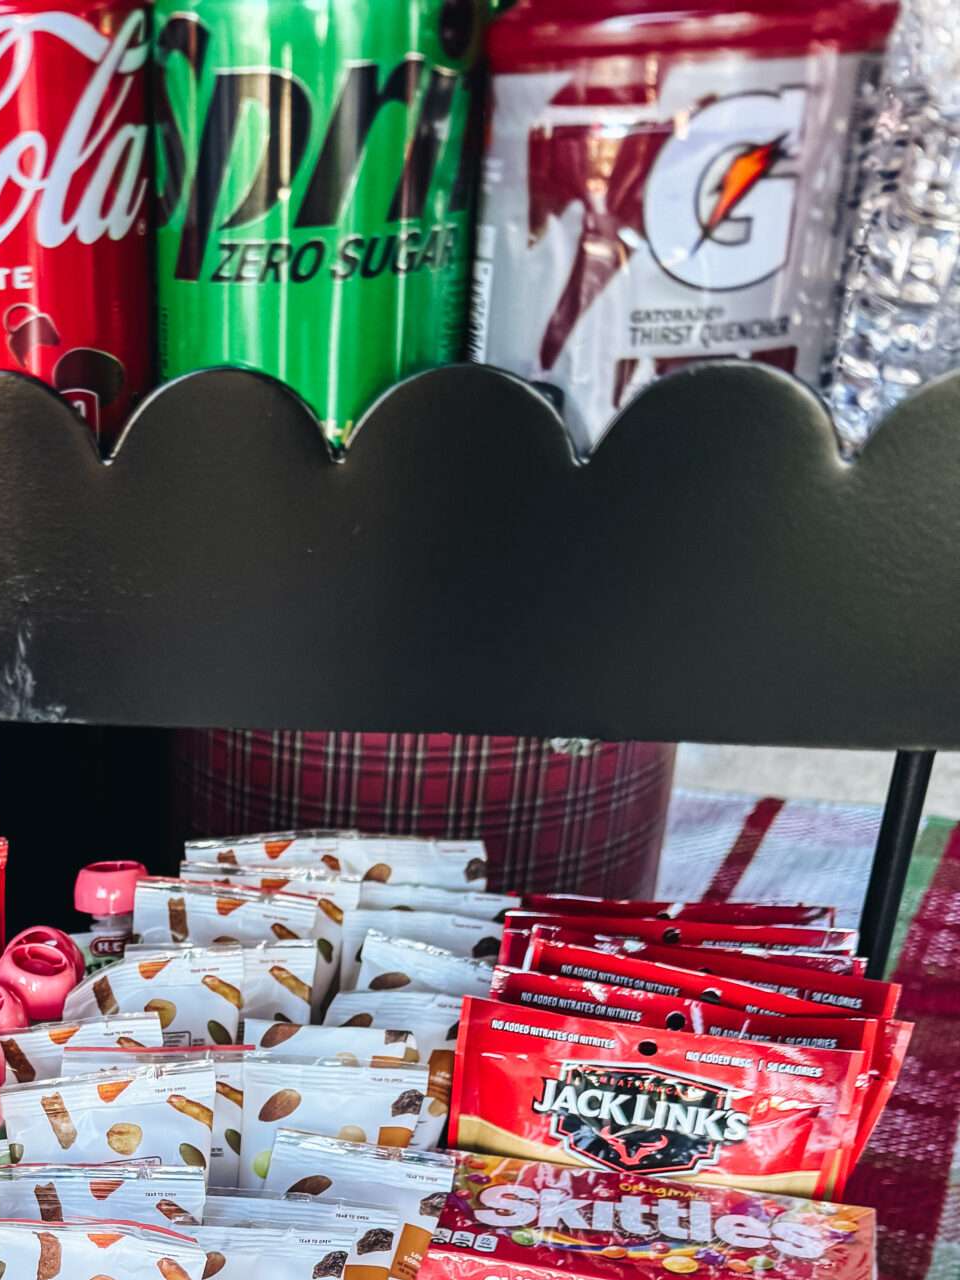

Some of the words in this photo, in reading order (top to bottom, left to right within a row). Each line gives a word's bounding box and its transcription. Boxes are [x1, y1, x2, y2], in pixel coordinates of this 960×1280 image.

[211, 237, 326, 283] ZERO
[330, 222, 458, 281] SUGAR
[629, 324, 689, 347] THIRST
[700, 315, 791, 348] QUENCHER
[561, 964, 572, 975] NO
[573, 965, 597, 980] ADDED
[598, 970, 633, 988] NITRATES
[645, 981, 680, 998] NITRITES
[521, 992, 532, 1004] NO
[533, 994, 558, 1009] ADDED
[559, 998, 594, 1014] NITRATES
[595, 1005, 606, 1017] OR
[606, 1006, 643, 1023] NITRITES
[822, 992, 862, 1010] CALORIES
[491, 1019, 503, 1030] NO
[503, 1021, 529, 1034] ADDED
[530, 1026, 567, 1042] NITRATES
[567, 1032, 579, 1043] OR
[580, 1035, 617, 1049] NITRITES
[686, 1052, 698, 1062] NO
[700, 1053, 730, 1066] ADDED
[778, 1063, 824, 1078] CALORIES
[533, 1078, 632, 1126] JACK
[633, 1099, 750, 1142] LINK'S
[473, 1184, 827, 1259] Skittles
